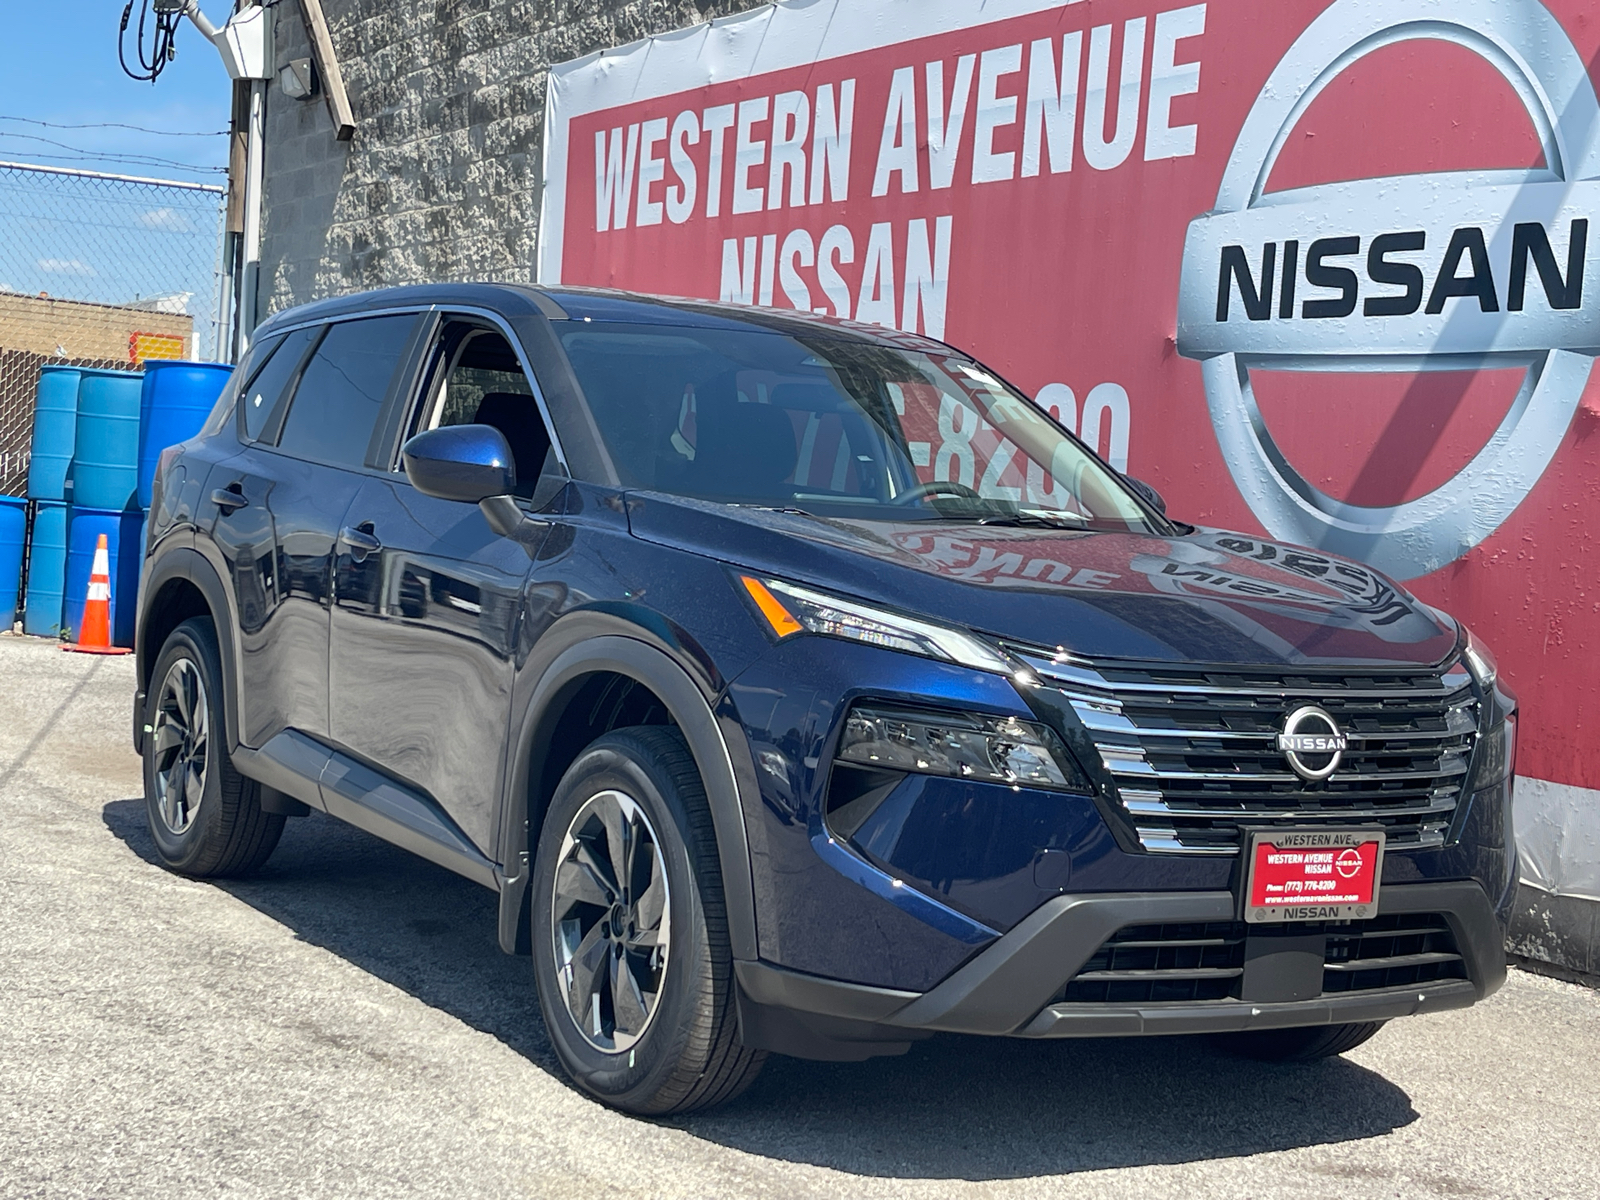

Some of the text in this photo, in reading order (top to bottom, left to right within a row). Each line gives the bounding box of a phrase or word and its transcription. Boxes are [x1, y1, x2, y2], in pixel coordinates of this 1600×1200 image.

[595, 5, 1206, 233] WESTERN AVENUE
[1216, 218, 1588, 322] NISSAN
[719, 214, 953, 343] NISSAN
[1281, 737, 1346, 750] NISSAN
[1284, 834, 1331, 846] WESTERN
[1267, 853, 1333, 864] WESTERN AVENUE
[1304, 864, 1332, 875] NISSAN
[1284, 880, 1303, 893] (773)
[1304, 880, 1336, 891] 776-8200
[1283, 906, 1339, 919] NISSAN
